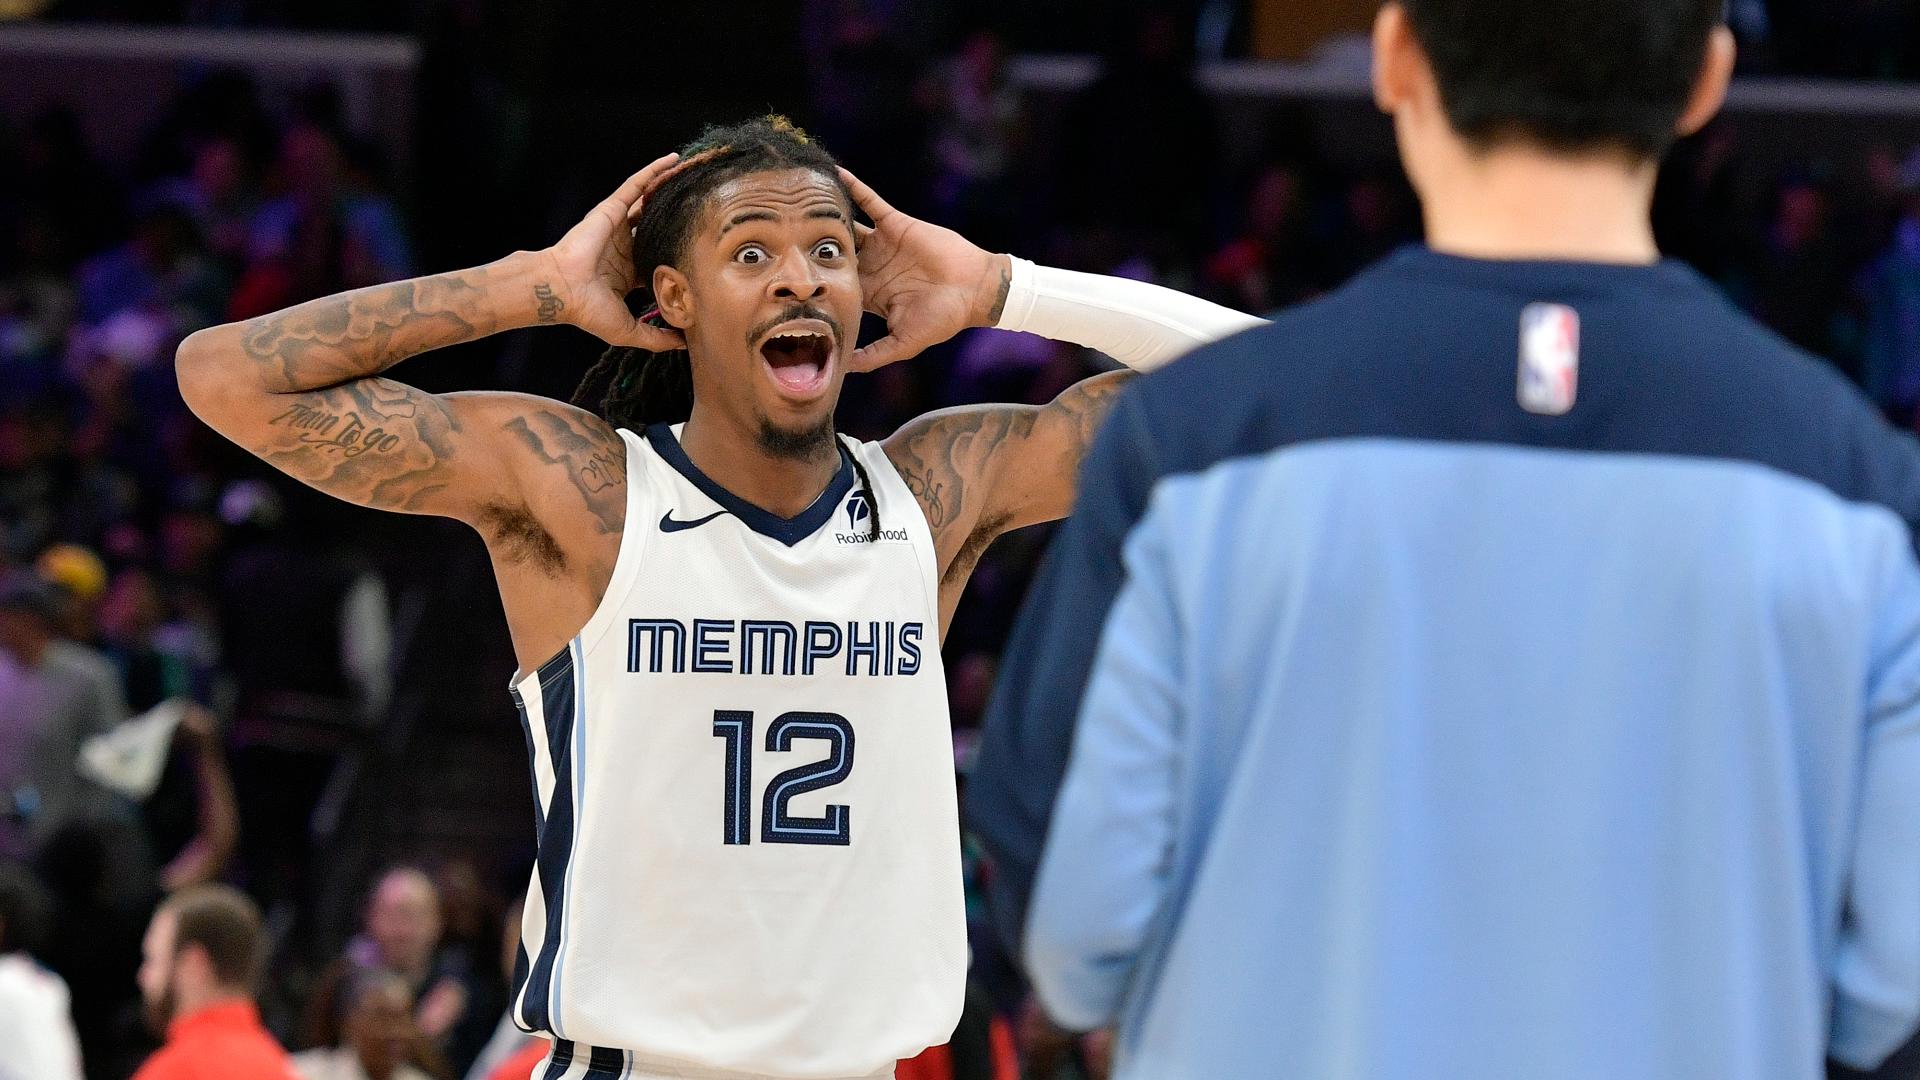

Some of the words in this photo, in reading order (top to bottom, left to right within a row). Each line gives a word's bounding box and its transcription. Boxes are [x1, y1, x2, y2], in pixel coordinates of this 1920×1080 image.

[344, 427, 400, 458] go
[627, 618, 923, 676] MEMPHIS
[712, 709, 856, 846] 12
